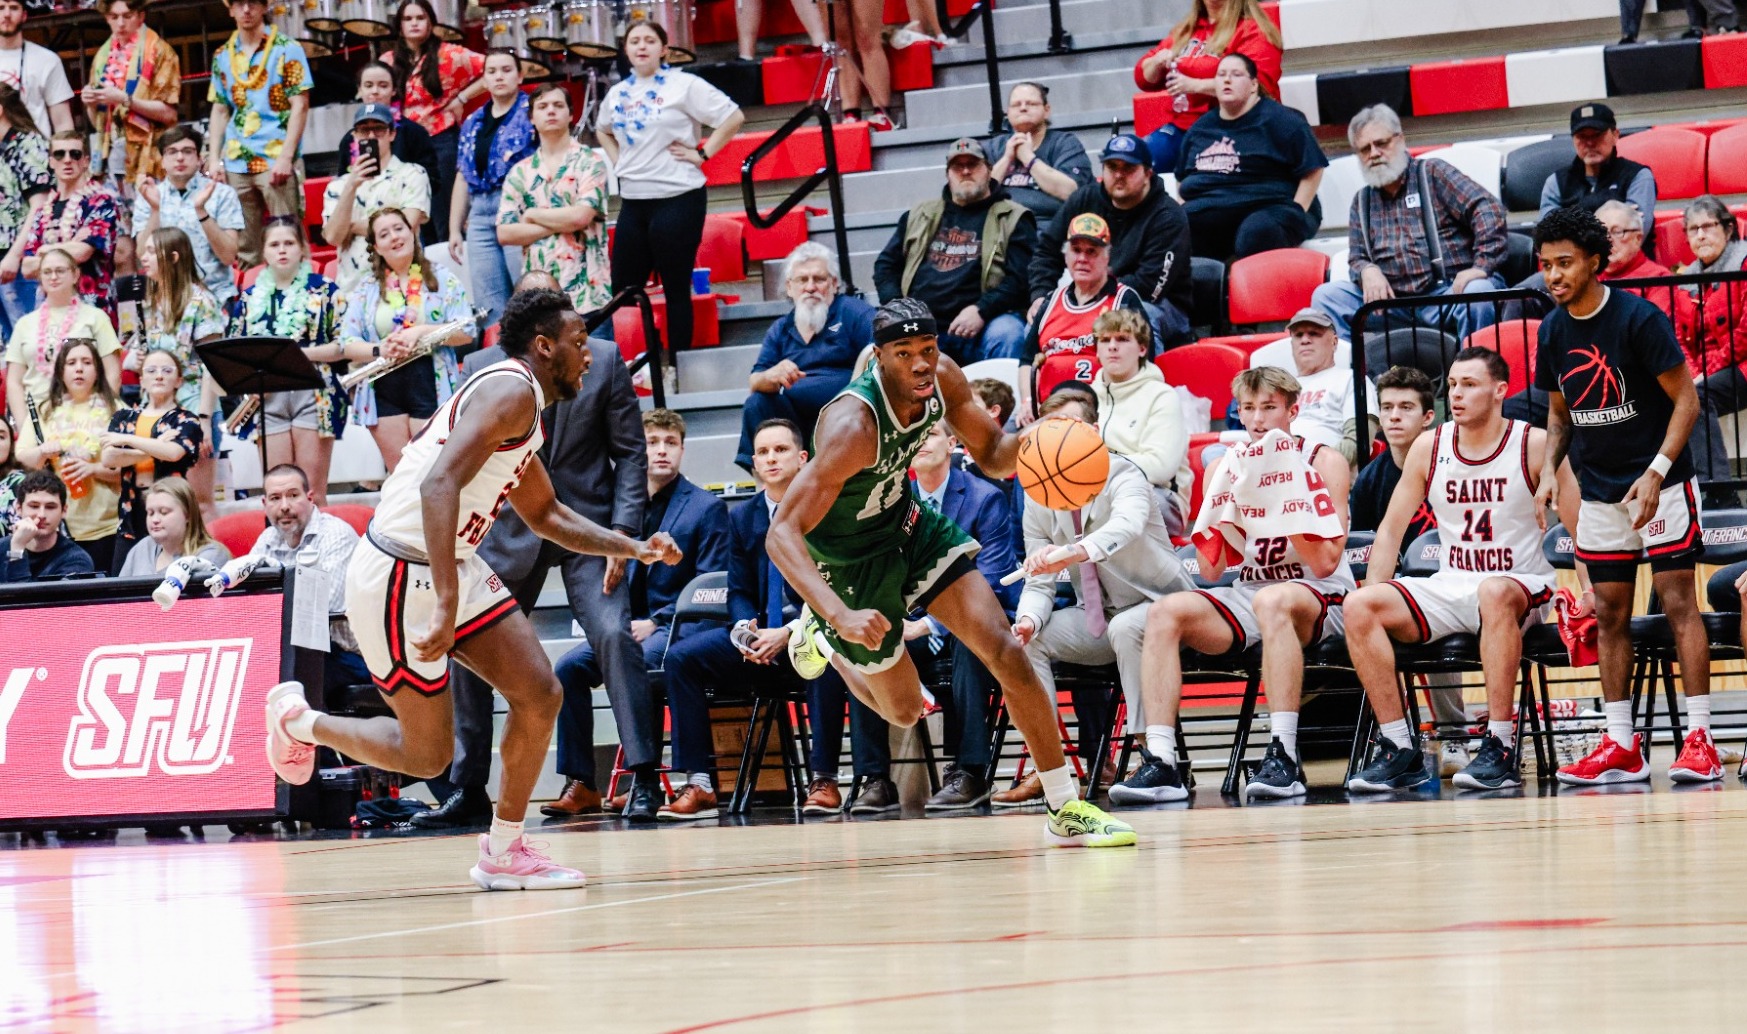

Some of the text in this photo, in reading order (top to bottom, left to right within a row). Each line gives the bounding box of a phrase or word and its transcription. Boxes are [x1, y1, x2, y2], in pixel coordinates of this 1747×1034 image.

[1075, 359, 1093, 381] 2
[1576, 403, 1637, 425] BASKETBALL
[1257, 471, 1293, 489] READY
[1445, 477, 1507, 504] SAINT
[1461, 509, 1493, 542] 14
[1648, 519, 1665, 537] SFU
[1254, 536, 1288, 567] 32
[1449, 545, 1513, 572] FRANCIS
[692, 589, 721, 603] SAINT
[67, 644, 246, 773] SFU
